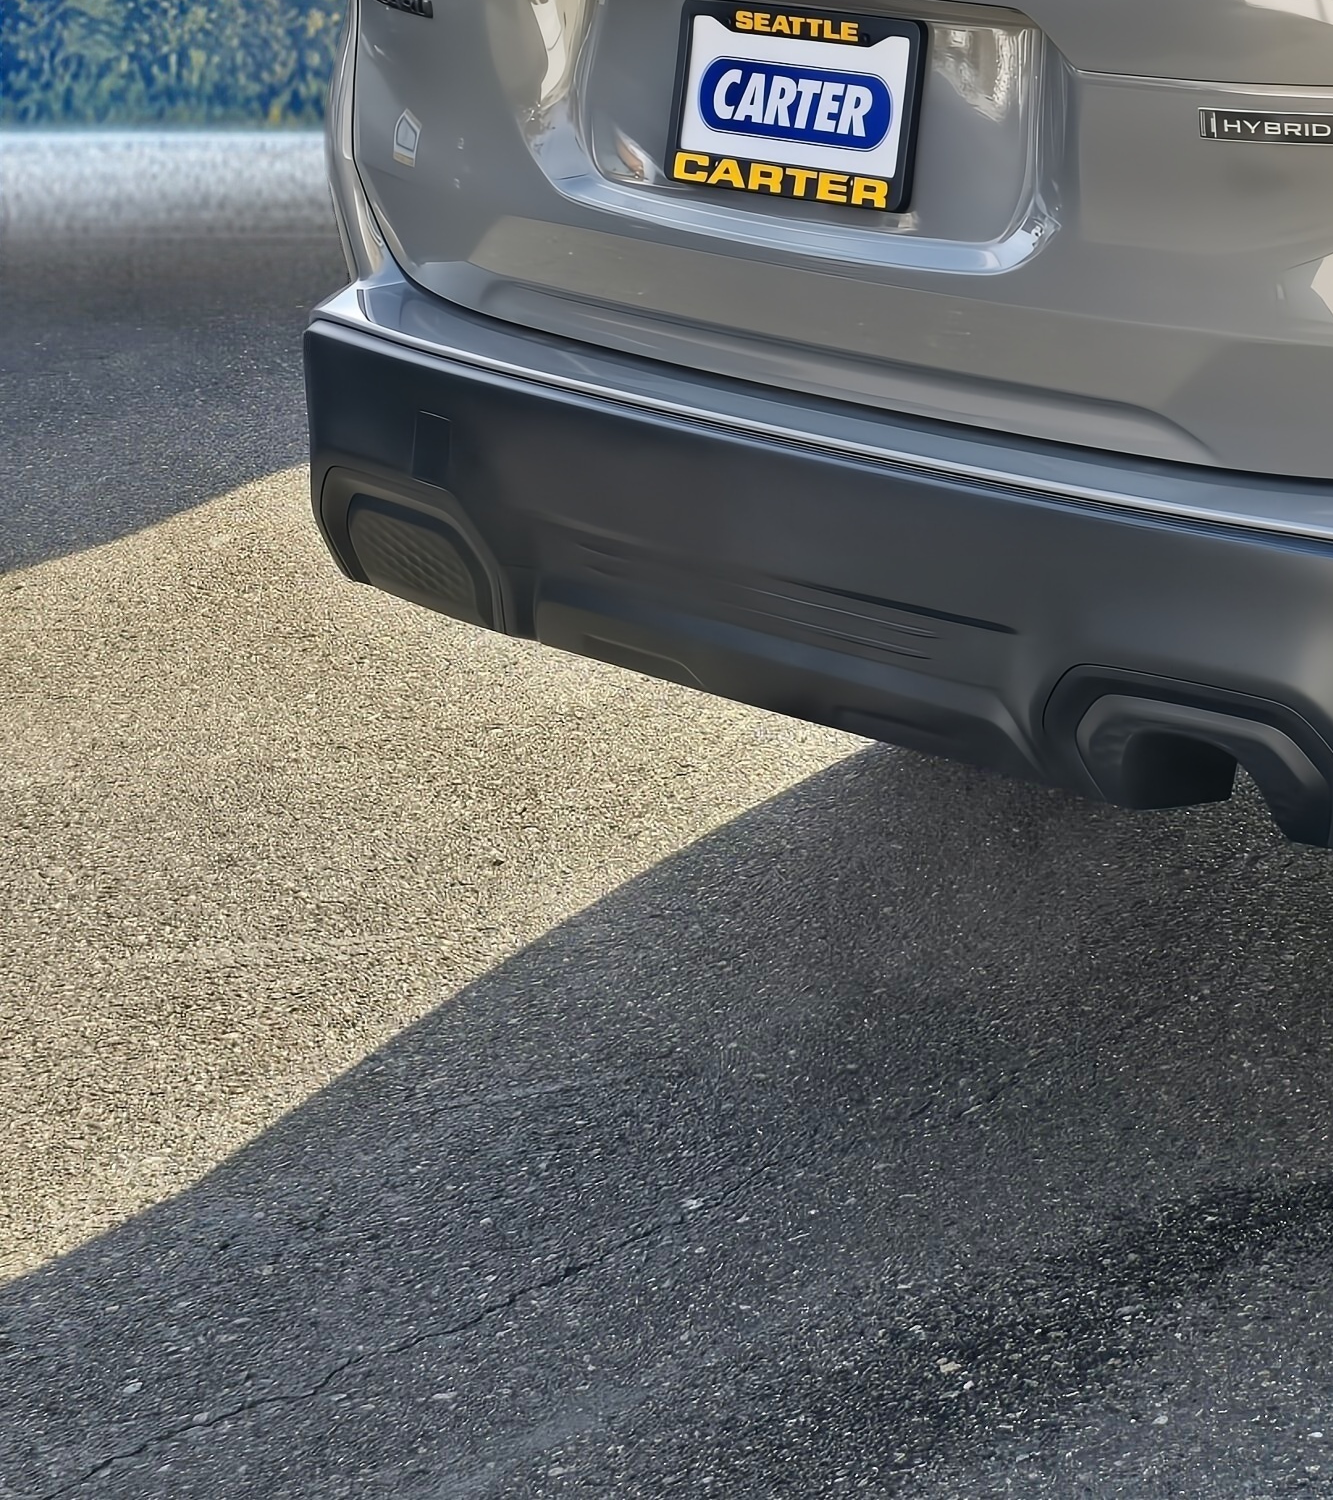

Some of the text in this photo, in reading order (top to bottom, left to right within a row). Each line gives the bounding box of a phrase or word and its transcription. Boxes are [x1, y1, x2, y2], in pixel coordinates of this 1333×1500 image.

[735, 10, 859, 42] SEATTLE
[713, 68, 873, 137] CARTER
[1223, 119, 1332, 137] HYBRID
[673, 151, 888, 208] CARTER
